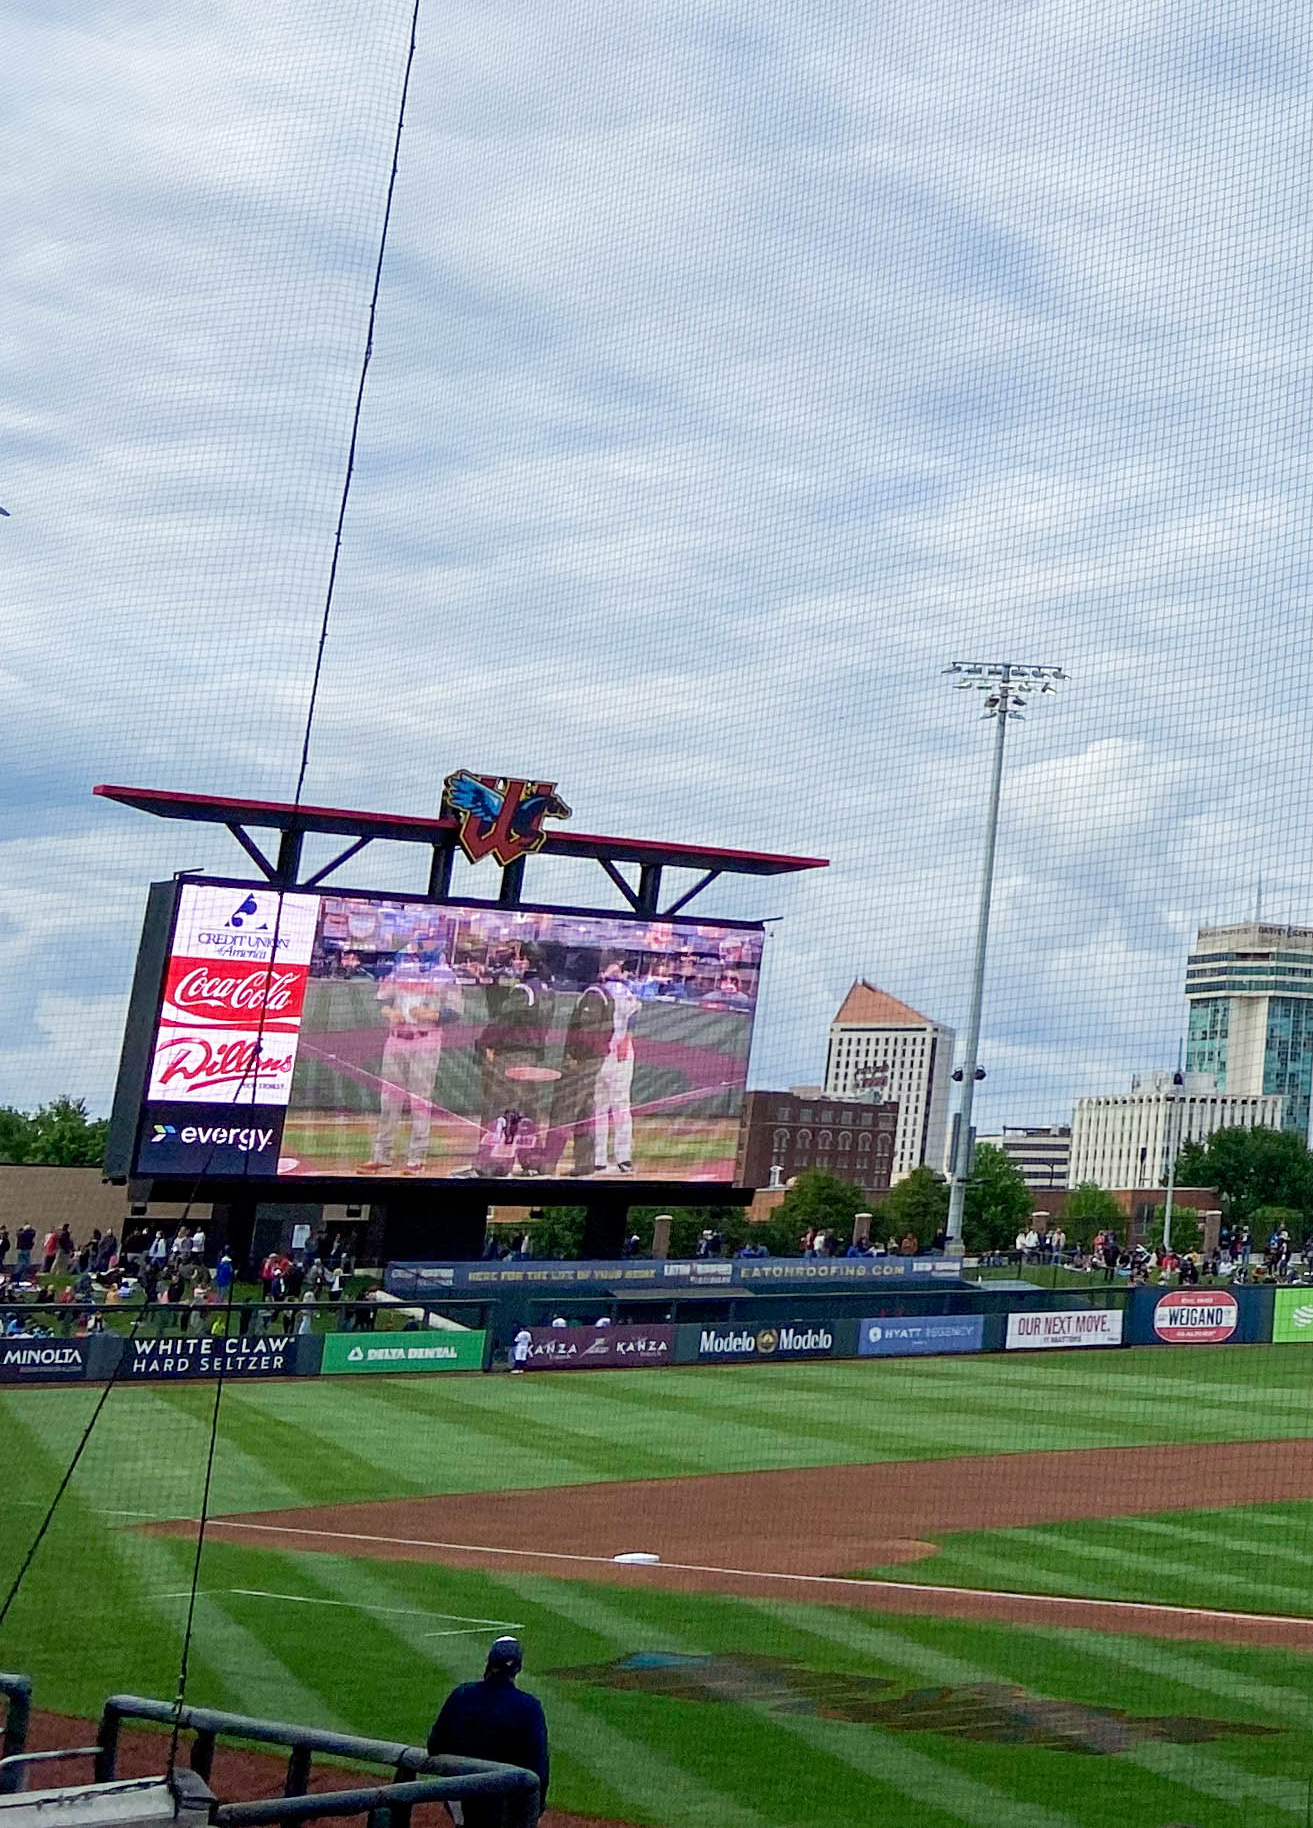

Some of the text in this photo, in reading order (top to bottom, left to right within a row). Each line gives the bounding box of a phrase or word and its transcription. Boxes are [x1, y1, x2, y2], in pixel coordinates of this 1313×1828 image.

[198, 932, 247, 947] CREDIT
[174, 967, 301, 1011] Coca-Cola
[181, 1125, 274, 1152] evergy
[1018, 1314, 1111, 1335] OUR NEXT MOVE.
[1169, 1307, 1223, 1326] WEIGAND
[700, 1328, 832, 1352] Modelo Modelo
[884, 1328, 922, 1339] HYATT
[134, 1338, 291, 1355] WHITE CLAW
[367, 1346, 458, 1361] DELTA DENTAL
[3, 1348, 82, 1364] MINOLTA
[132, 1355, 285, 1373] HARD SELTZER
